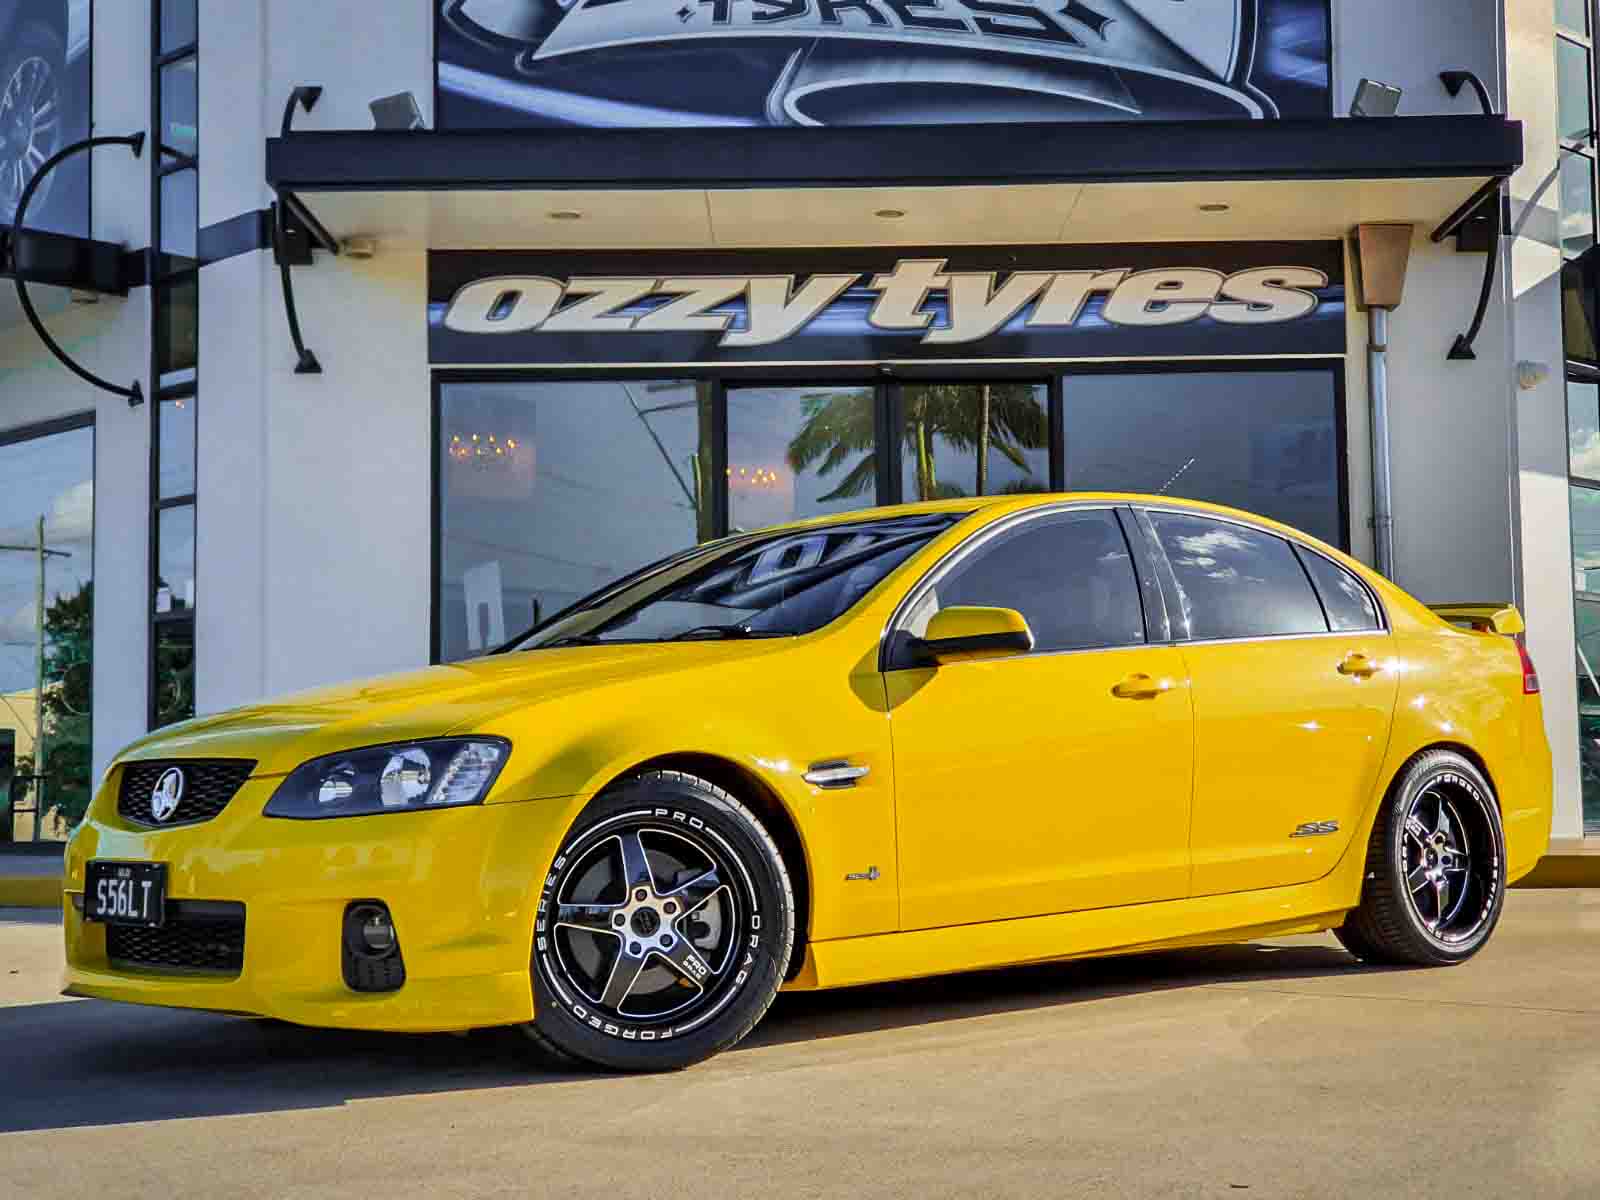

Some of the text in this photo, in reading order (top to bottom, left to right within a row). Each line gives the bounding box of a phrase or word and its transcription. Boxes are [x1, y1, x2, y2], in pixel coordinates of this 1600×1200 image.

[443, 258, 1329, 346] ozzy tyres
[654, 807, 704, 829] PRO
[734, 914, 760, 986] DRAG
[573, 1004, 673, 1041] FORGED
